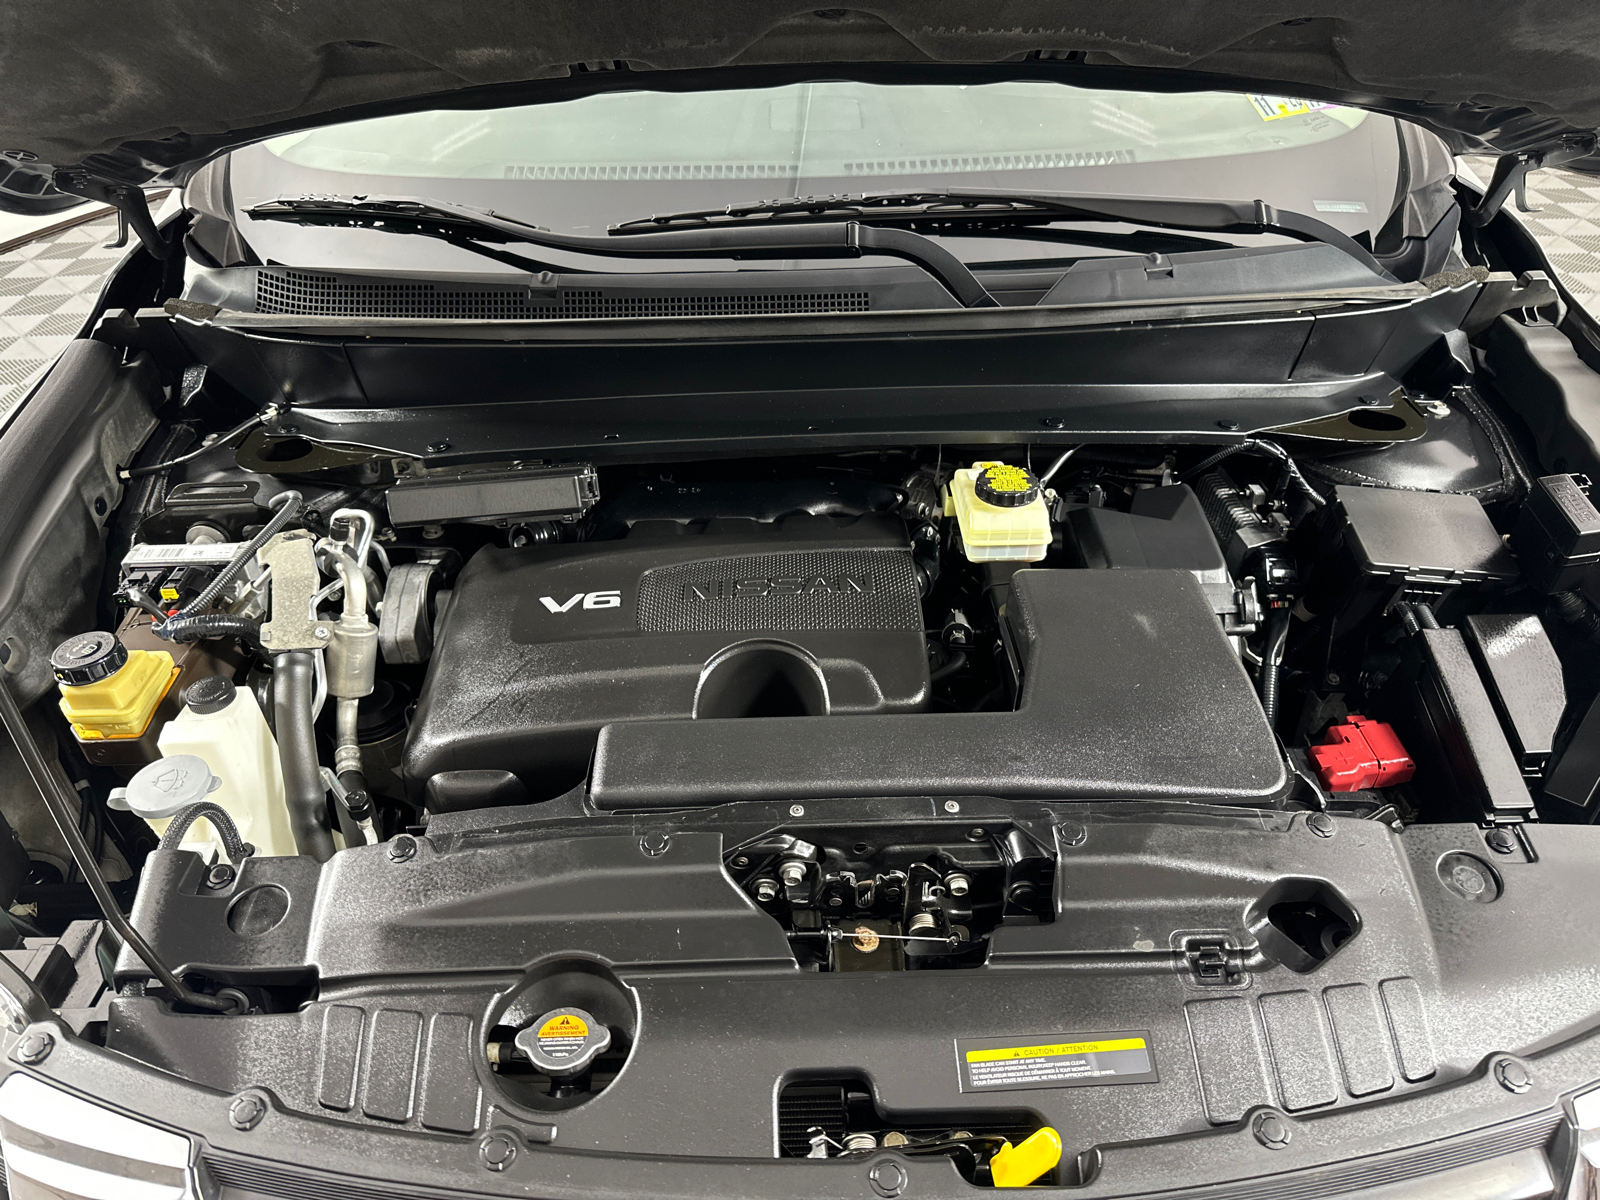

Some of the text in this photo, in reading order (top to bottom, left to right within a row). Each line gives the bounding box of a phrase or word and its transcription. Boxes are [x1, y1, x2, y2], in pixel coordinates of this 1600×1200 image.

[684, 571, 873, 602] NISSAN
[538, 590, 621, 613] V6
[1024, 1048, 1054, 1056] CAUTION
[1062, 1045, 1098, 1053] ATTENTION
